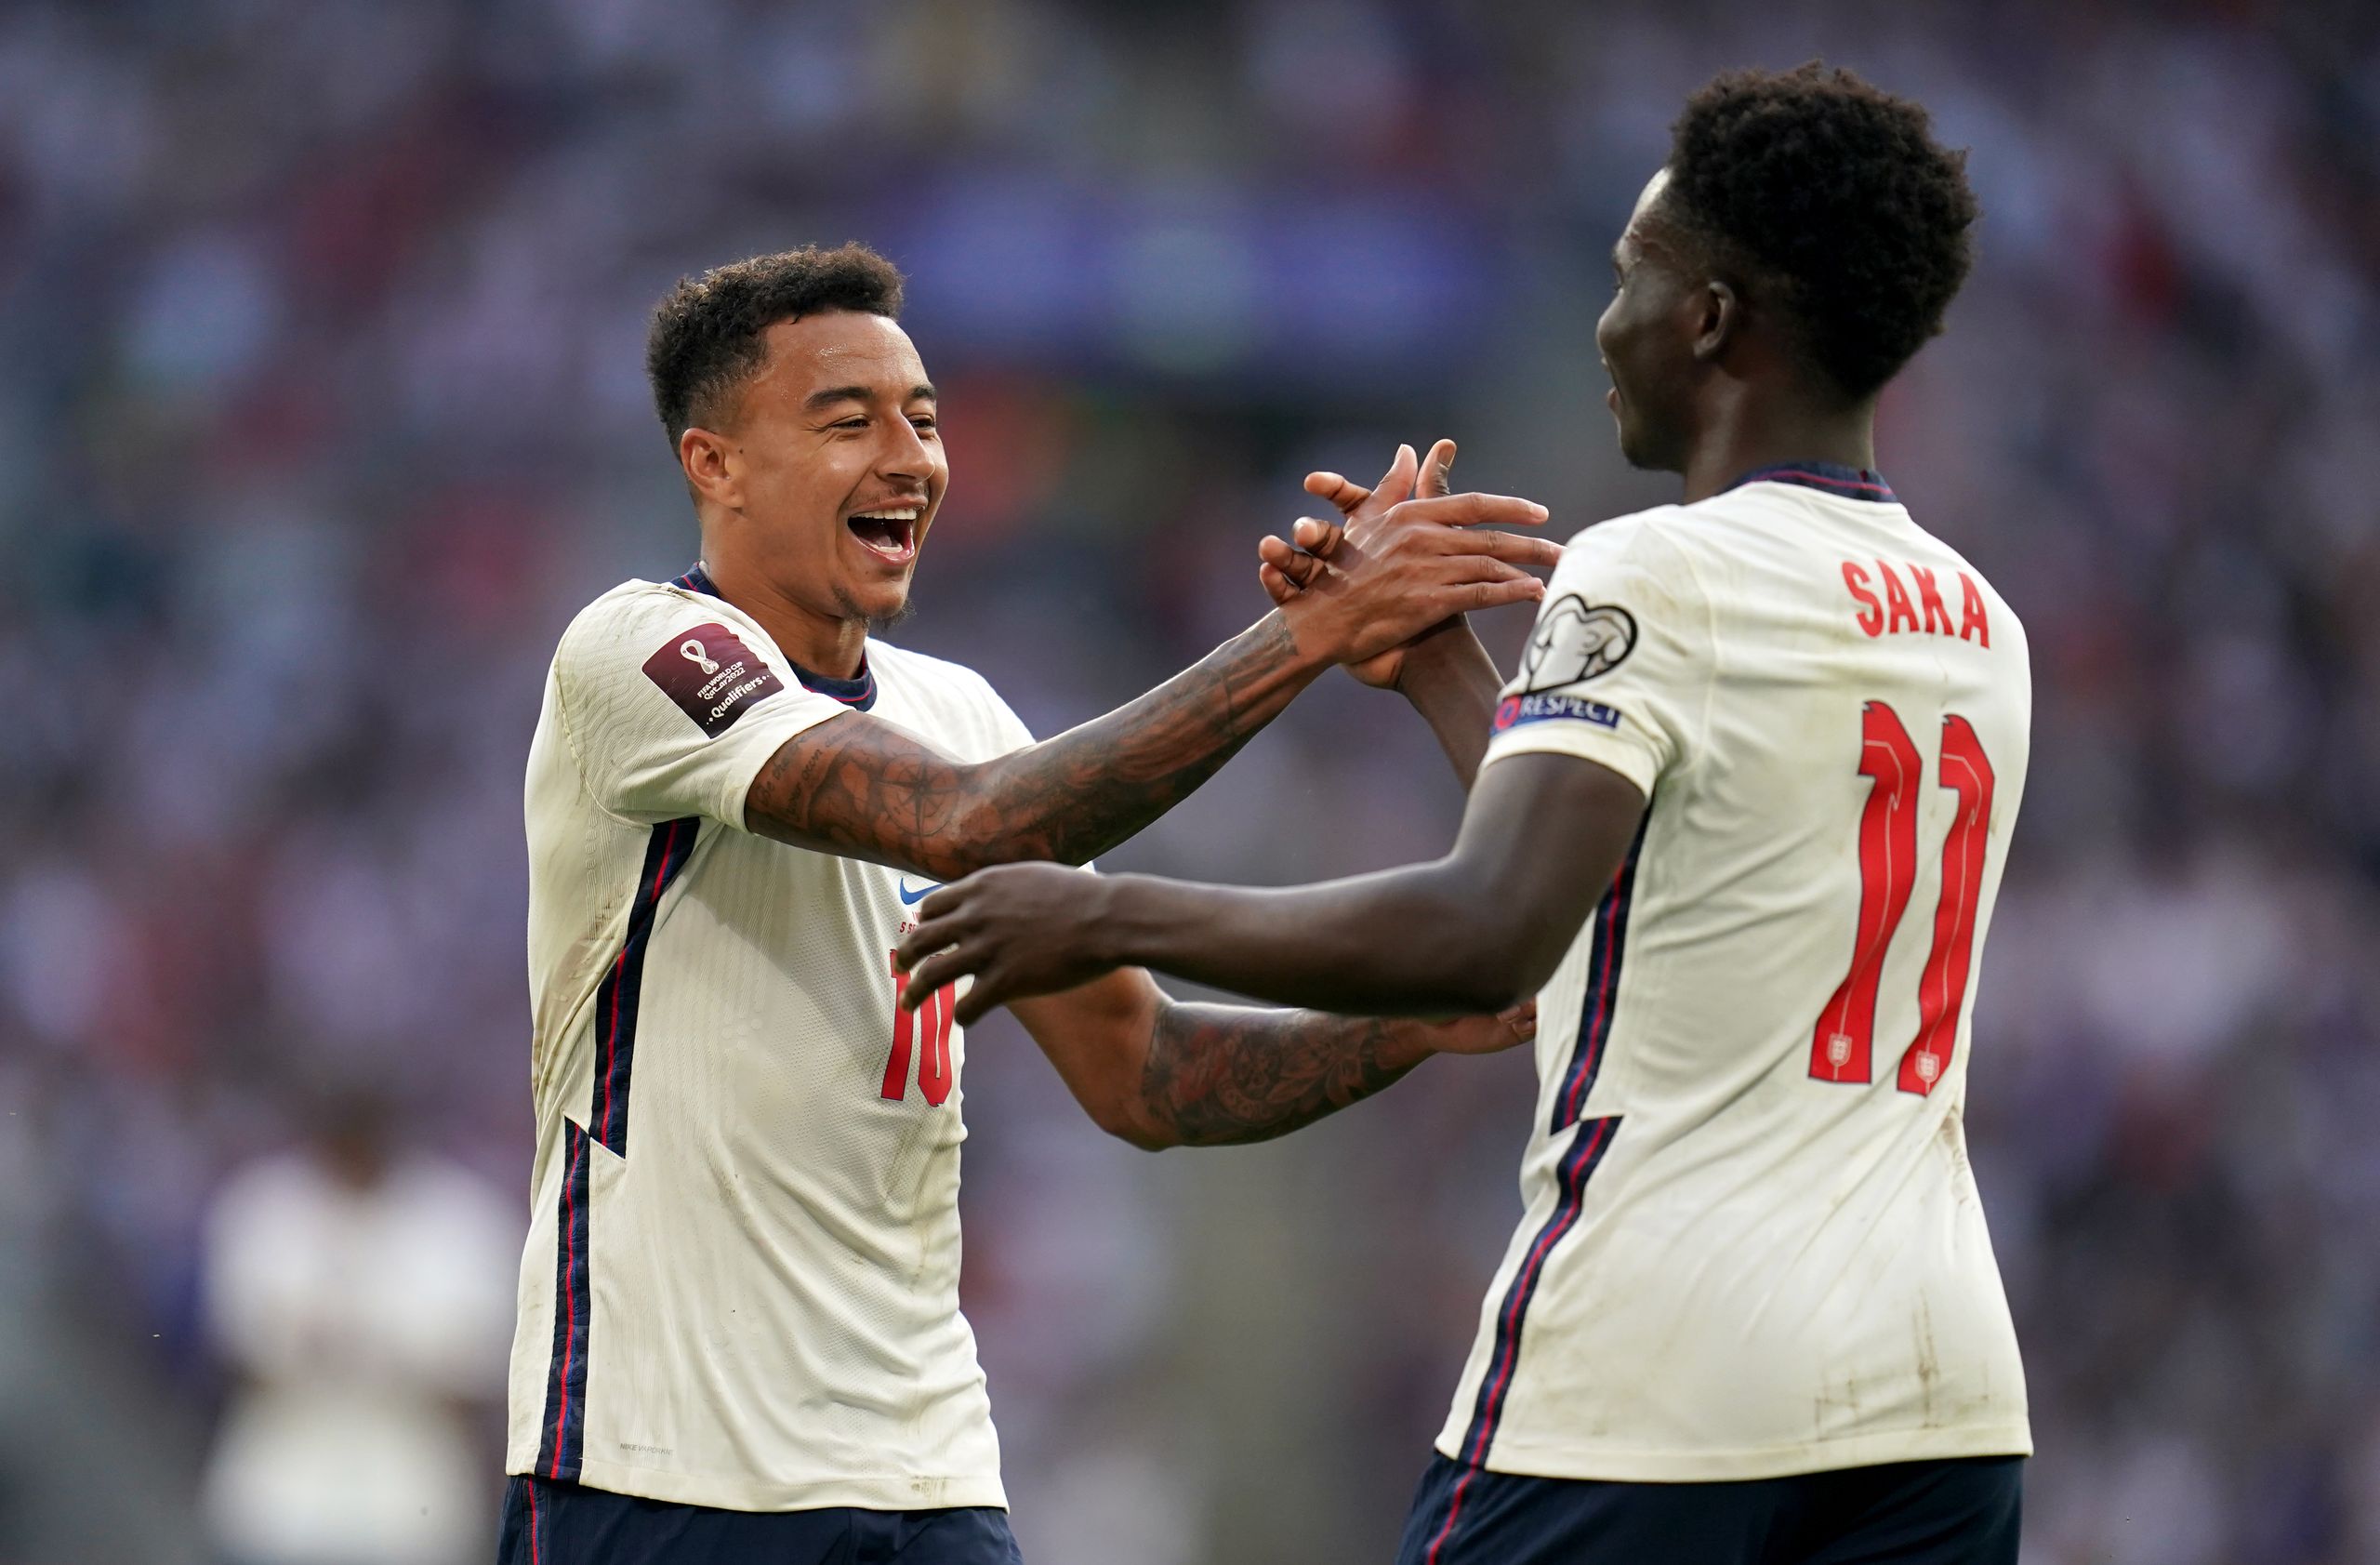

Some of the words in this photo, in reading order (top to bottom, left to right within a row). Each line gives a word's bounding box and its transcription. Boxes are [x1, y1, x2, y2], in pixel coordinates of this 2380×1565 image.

[1841, 558, 1990, 649] SAKA
[696, 683, 712, 698] FIFA
[708, 668, 732, 687] WORLD
[731, 660, 743, 670] CUP
[710, 676, 763, 720] Qualifiers
[1519, 696, 1616, 723] RESPECT
[1807, 699, 1995, 1097] 11
[880, 948, 956, 1107] 10
[619, 1443, 638, 1452] NIKE
